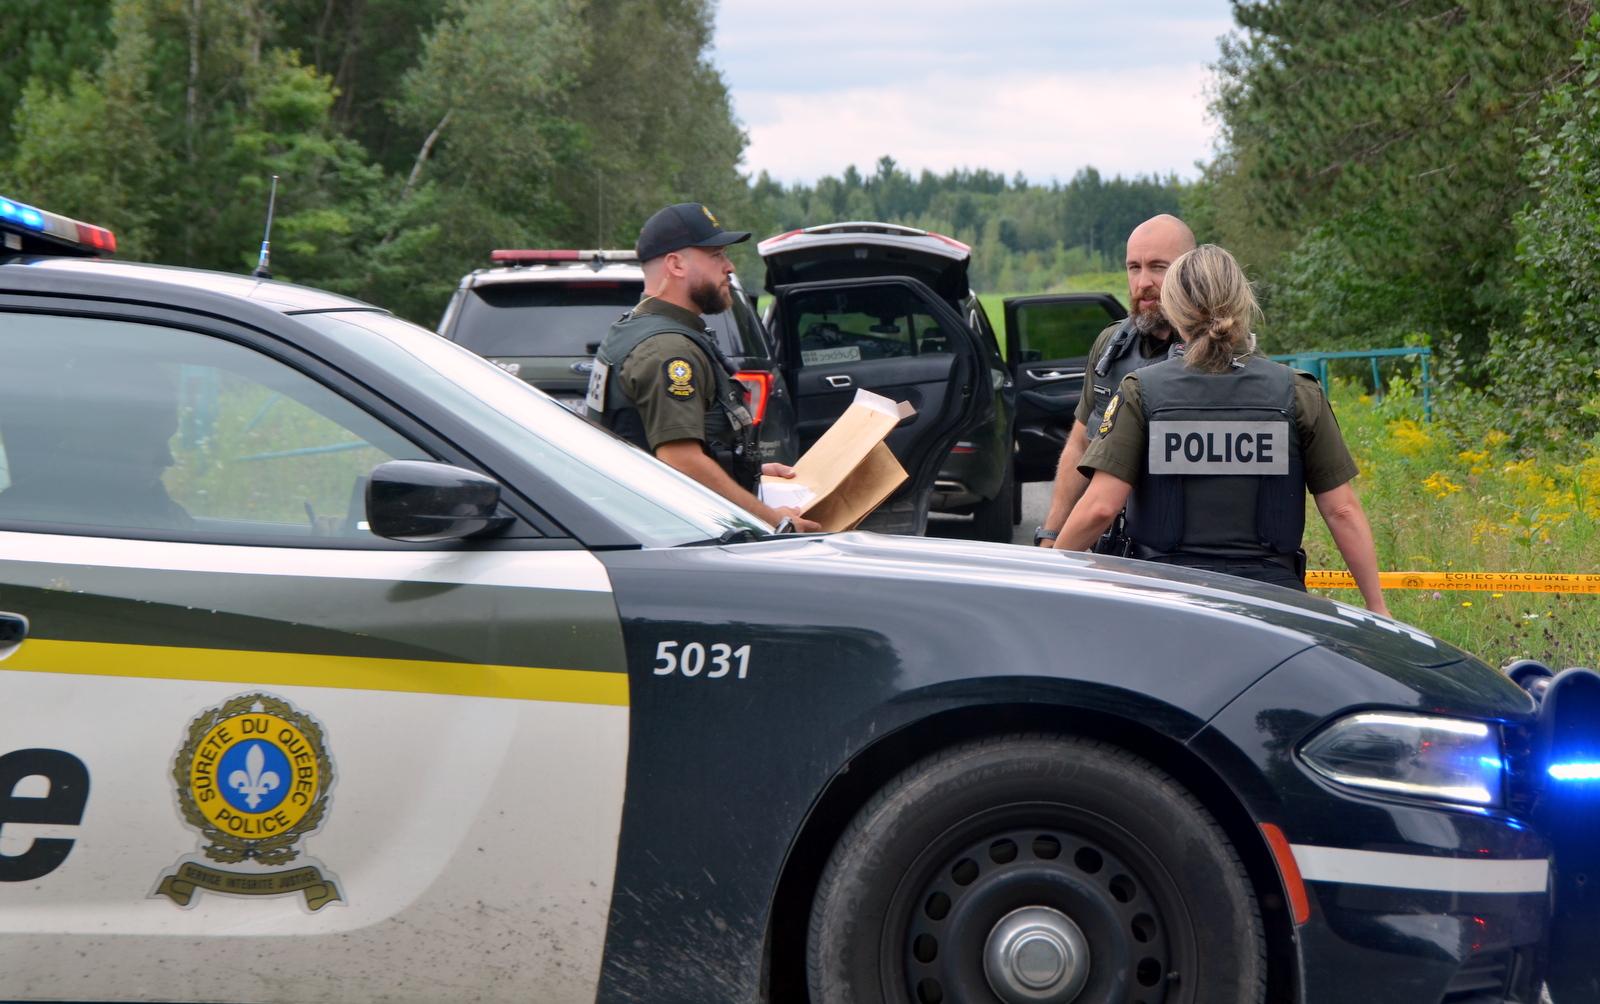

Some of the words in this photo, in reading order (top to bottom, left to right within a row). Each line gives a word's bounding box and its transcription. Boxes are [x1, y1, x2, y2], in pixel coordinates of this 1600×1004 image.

[1164, 432, 1274, 464] POLICE
[653, 640, 751, 679] 5031
[242, 718, 270, 734] DU
[278, 728, 316, 807] QUÉBEC
[215, 808, 291, 834] POLICE
[185, 866, 222, 885] SERVICE
[279, 870, 317, 888] JUSTICE
